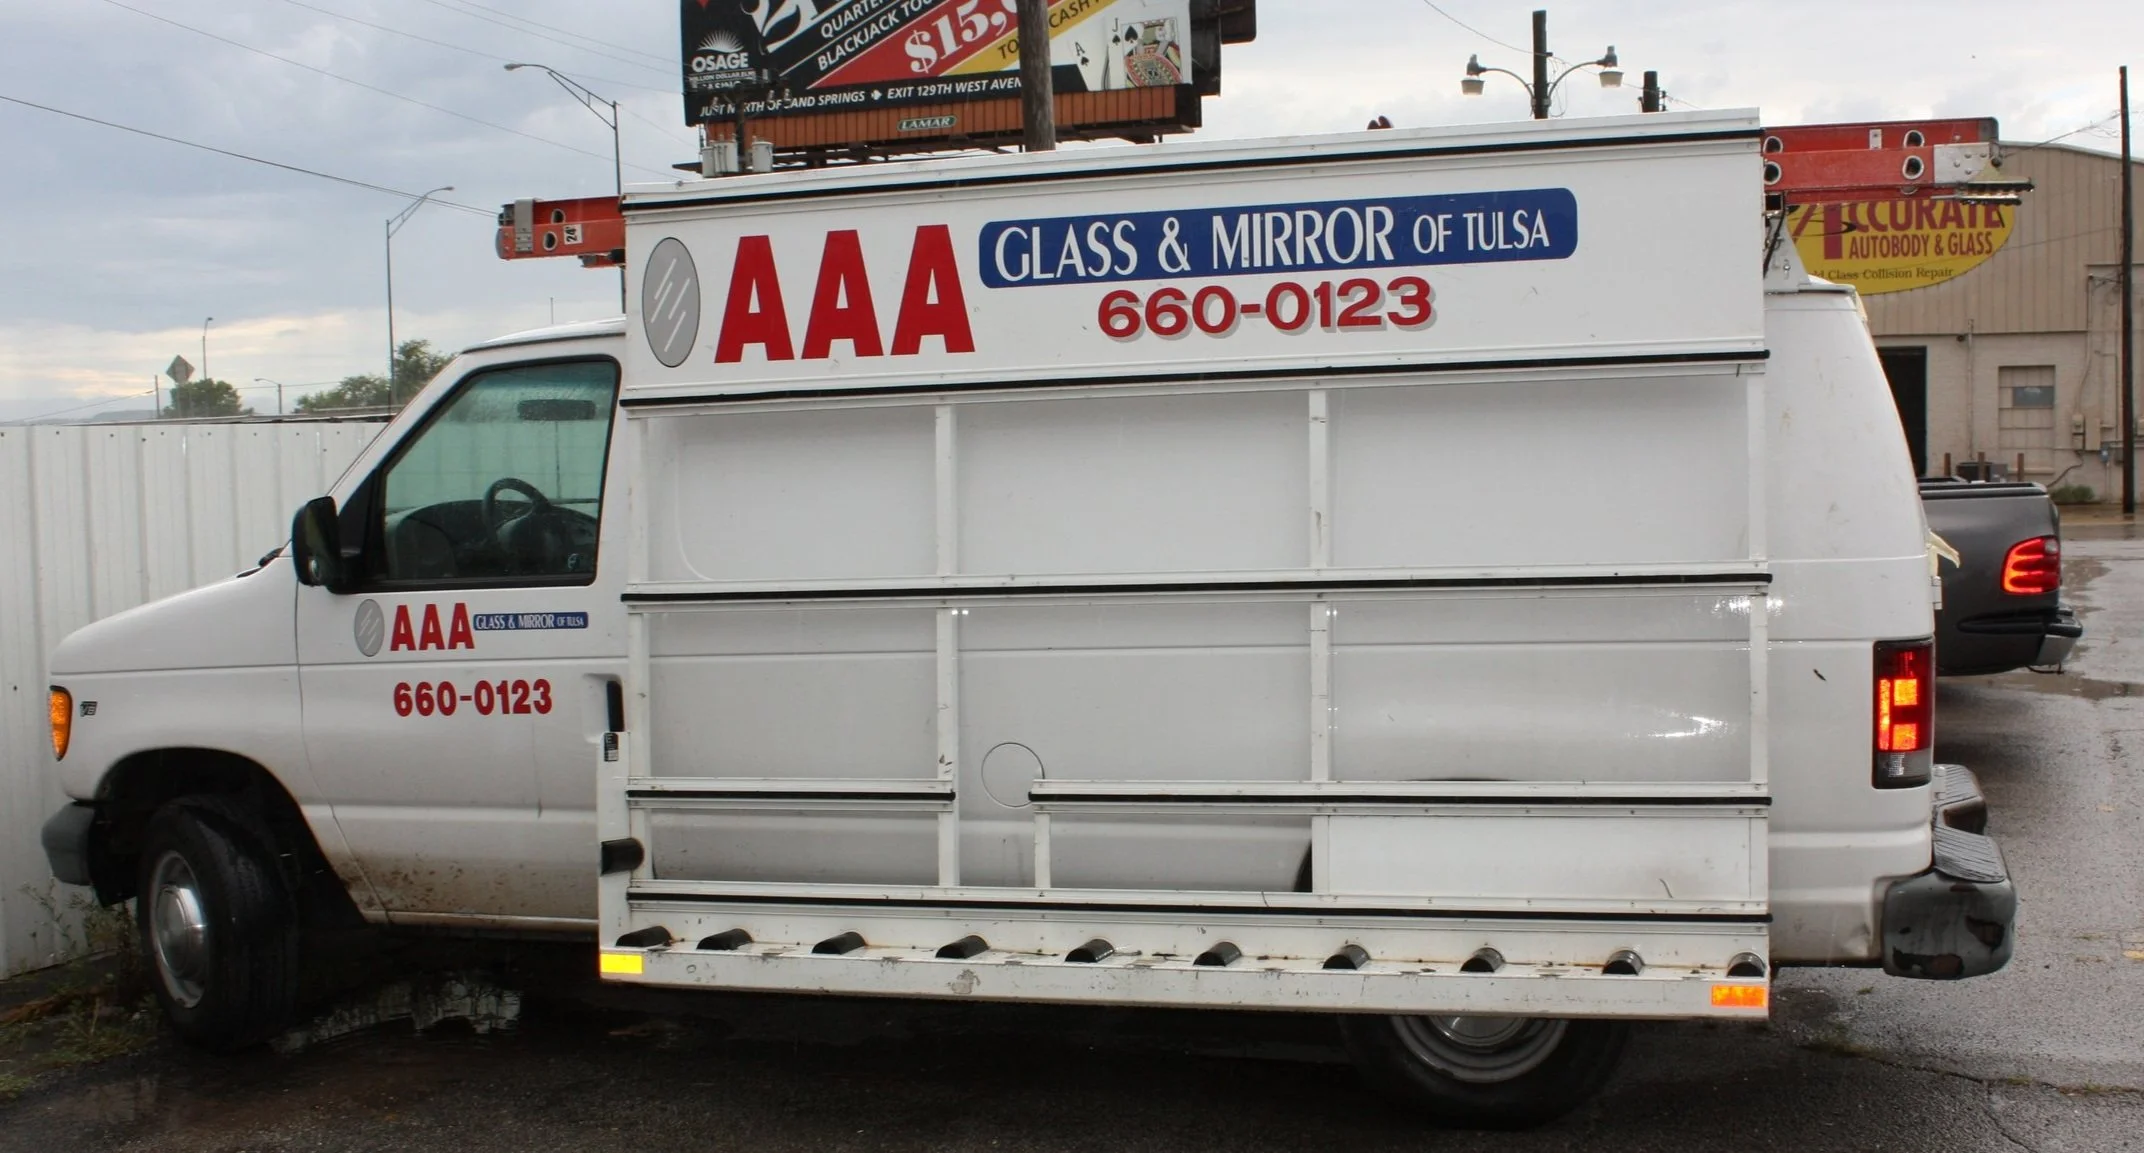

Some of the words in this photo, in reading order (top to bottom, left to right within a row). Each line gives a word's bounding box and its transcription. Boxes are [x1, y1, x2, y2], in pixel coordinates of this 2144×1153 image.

[821, 0, 888, 38] QUARTE
[1048, 0, 1090, 28] CASH
[817, 10, 900, 71] BLACKJACK
[692, 52, 749, 73] OSAGE
[727, 101, 765, 114] NRTH
[818, 91, 866, 106] SPRINGS
[887, 86, 914, 99] EXIT
[917, 83, 952, 97] 129TH
[955, 80, 988, 93] WEST
[990, 77, 1022, 90] AVEN
[901, 117, 951, 129] LAMAR
[1848, 233, 1929, 260] AUTOBODY
[1934, 234, 1944, 256] &
[1947, 231, 1993, 256] GLASS
[714, 224, 975, 363] AAA
[995, 220, 1138, 282] GLASS
[1158, 217, 1191, 273] &
[1212, 205, 1394, 269] MIRROR
[1412, 214, 1453, 254] OF
[1463, 209, 1550, 252] TULSA
[1862, 266, 1913, 280] Collision
[1916, 267, 1954, 279] Repair
[1097, 276, 1434, 341] 660-0123
[390, 603, 475, 651] AAA
[475, 615, 506, 630] GLASS
[508, 615, 515, 629] &
[518, 614, 554, 629] MIRROR
[557, 616, 566, 627] OF
[393, 678, 553, 717] 660-0123
